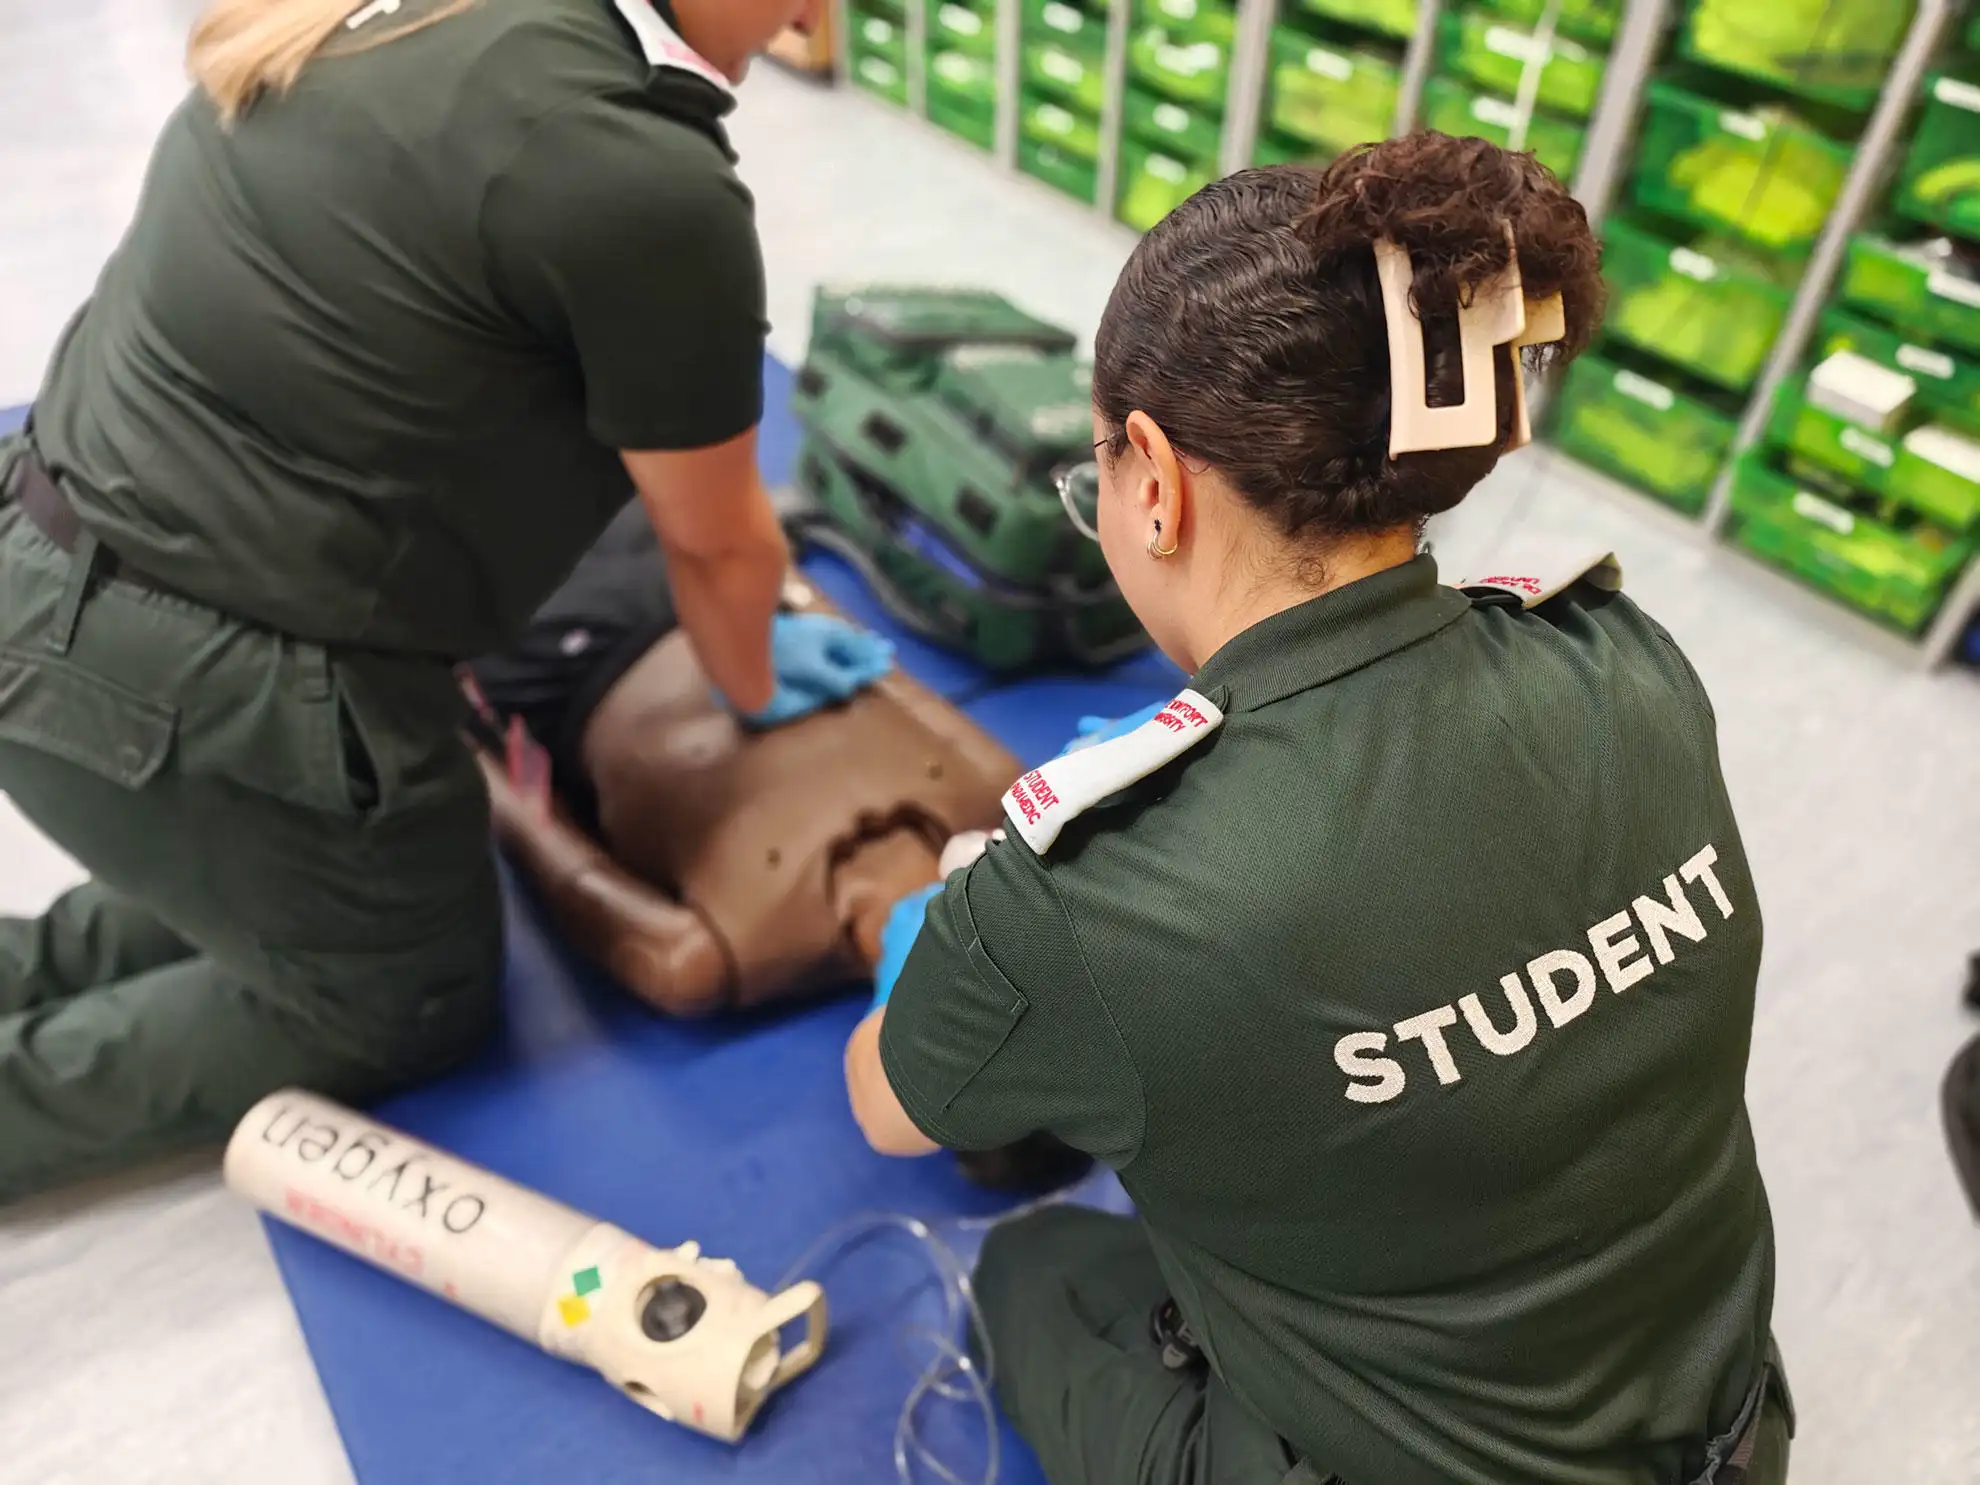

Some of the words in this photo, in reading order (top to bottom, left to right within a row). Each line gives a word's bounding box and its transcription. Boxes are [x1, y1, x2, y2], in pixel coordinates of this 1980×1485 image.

[1023, 770, 1060, 810] STUDENT
[1334, 844, 1735, 1104] STUDENT
[262, 1106, 486, 1234] oxygen
